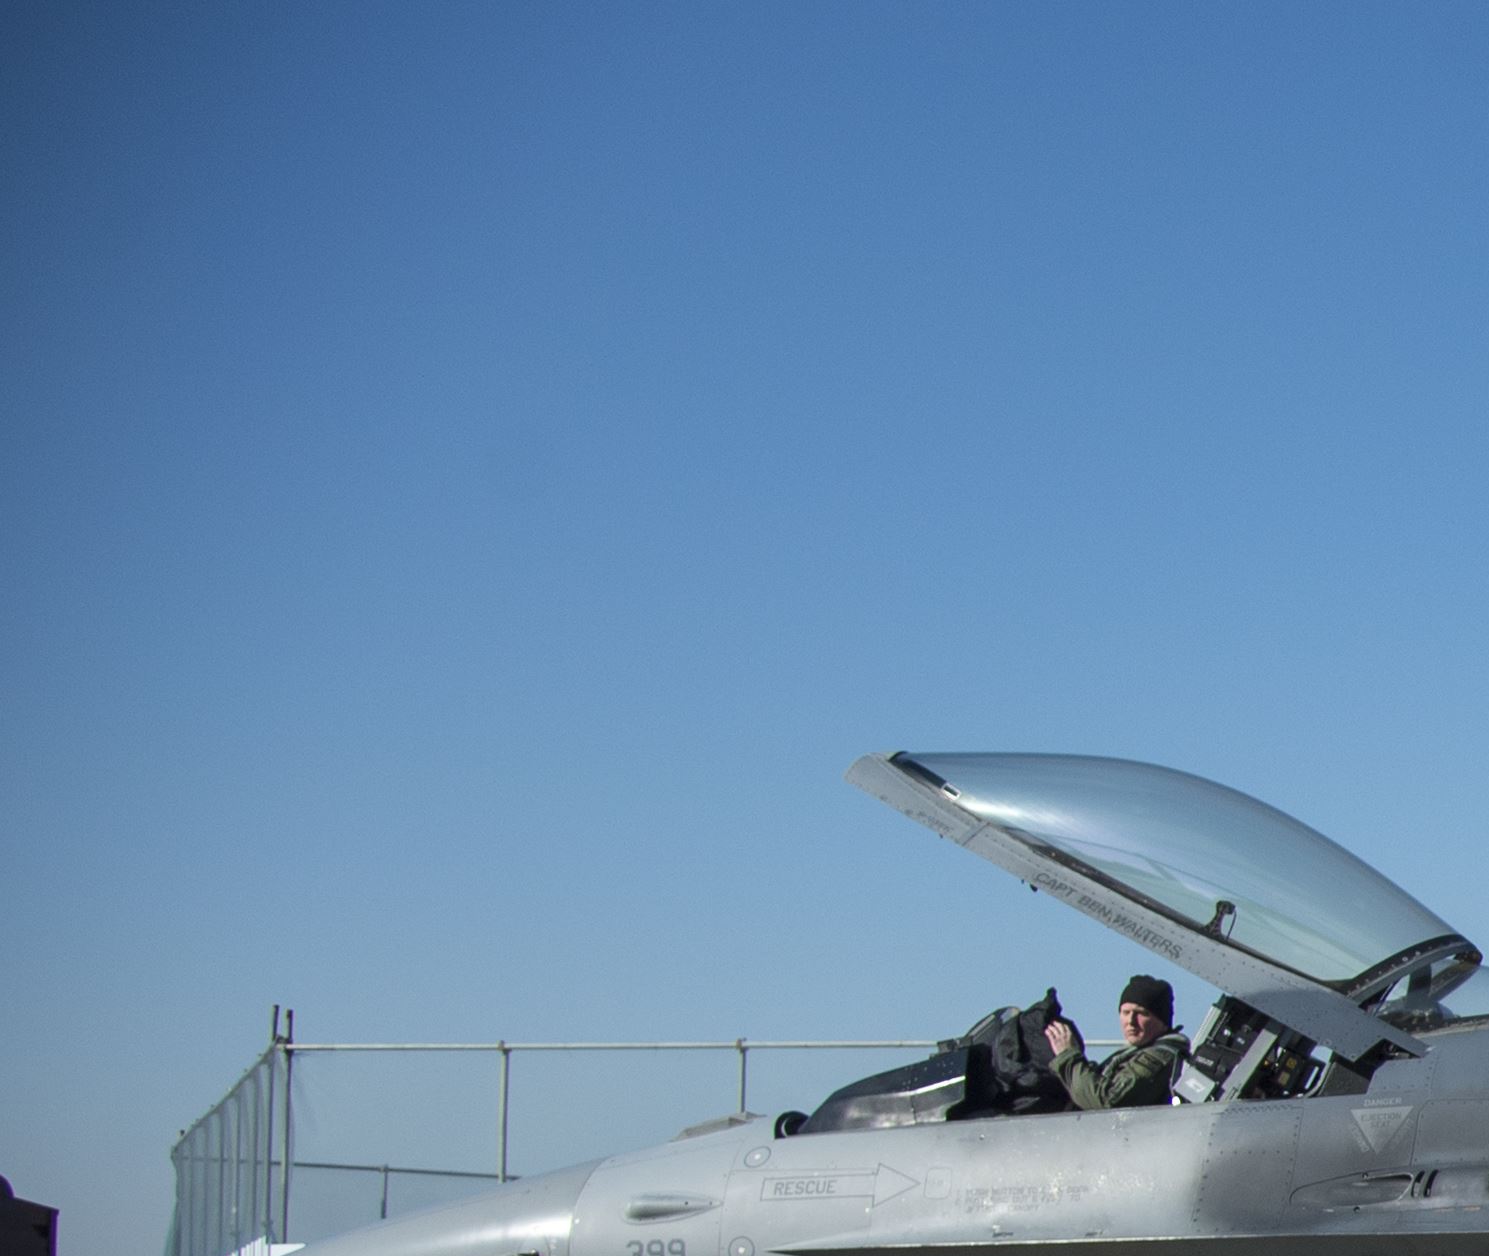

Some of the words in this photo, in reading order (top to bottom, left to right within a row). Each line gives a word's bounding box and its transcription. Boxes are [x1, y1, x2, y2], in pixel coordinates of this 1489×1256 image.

[1034, 872, 1078, 898] CAPT
[1111, 914, 1184, 960] WALTERS
[773, 1179, 838, 1196] RESCUE
